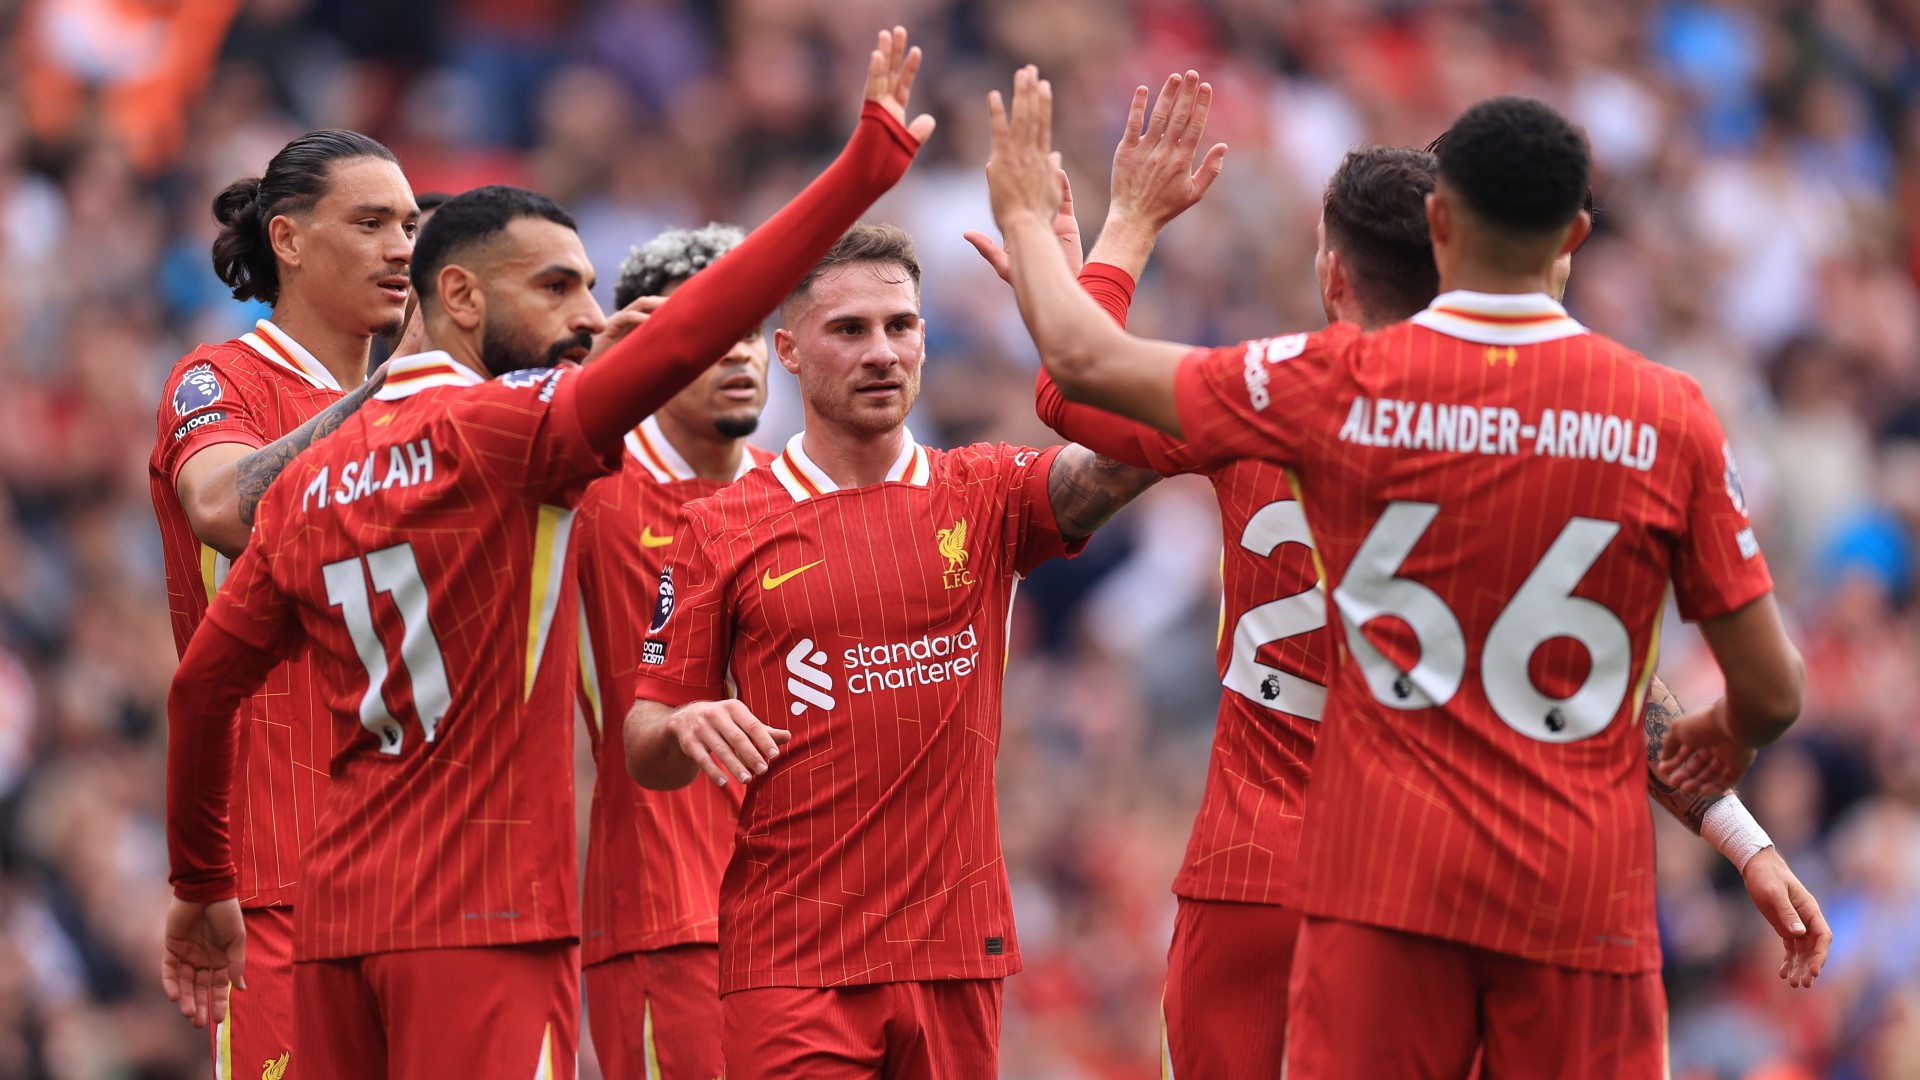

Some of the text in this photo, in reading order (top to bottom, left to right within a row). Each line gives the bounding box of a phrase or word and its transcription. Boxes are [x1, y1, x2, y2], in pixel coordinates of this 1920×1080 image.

[174, 412, 221, 441] No room
[1339, 395, 1657, 471] ALEXANDER-ARNOLD
[942, 570, 976, 589] L.F.C.
[1332, 501, 1632, 743] 66
[321, 541, 452, 756] 11
[643, 641, 663, 654] oom
[843, 624, 978, 669] standard
